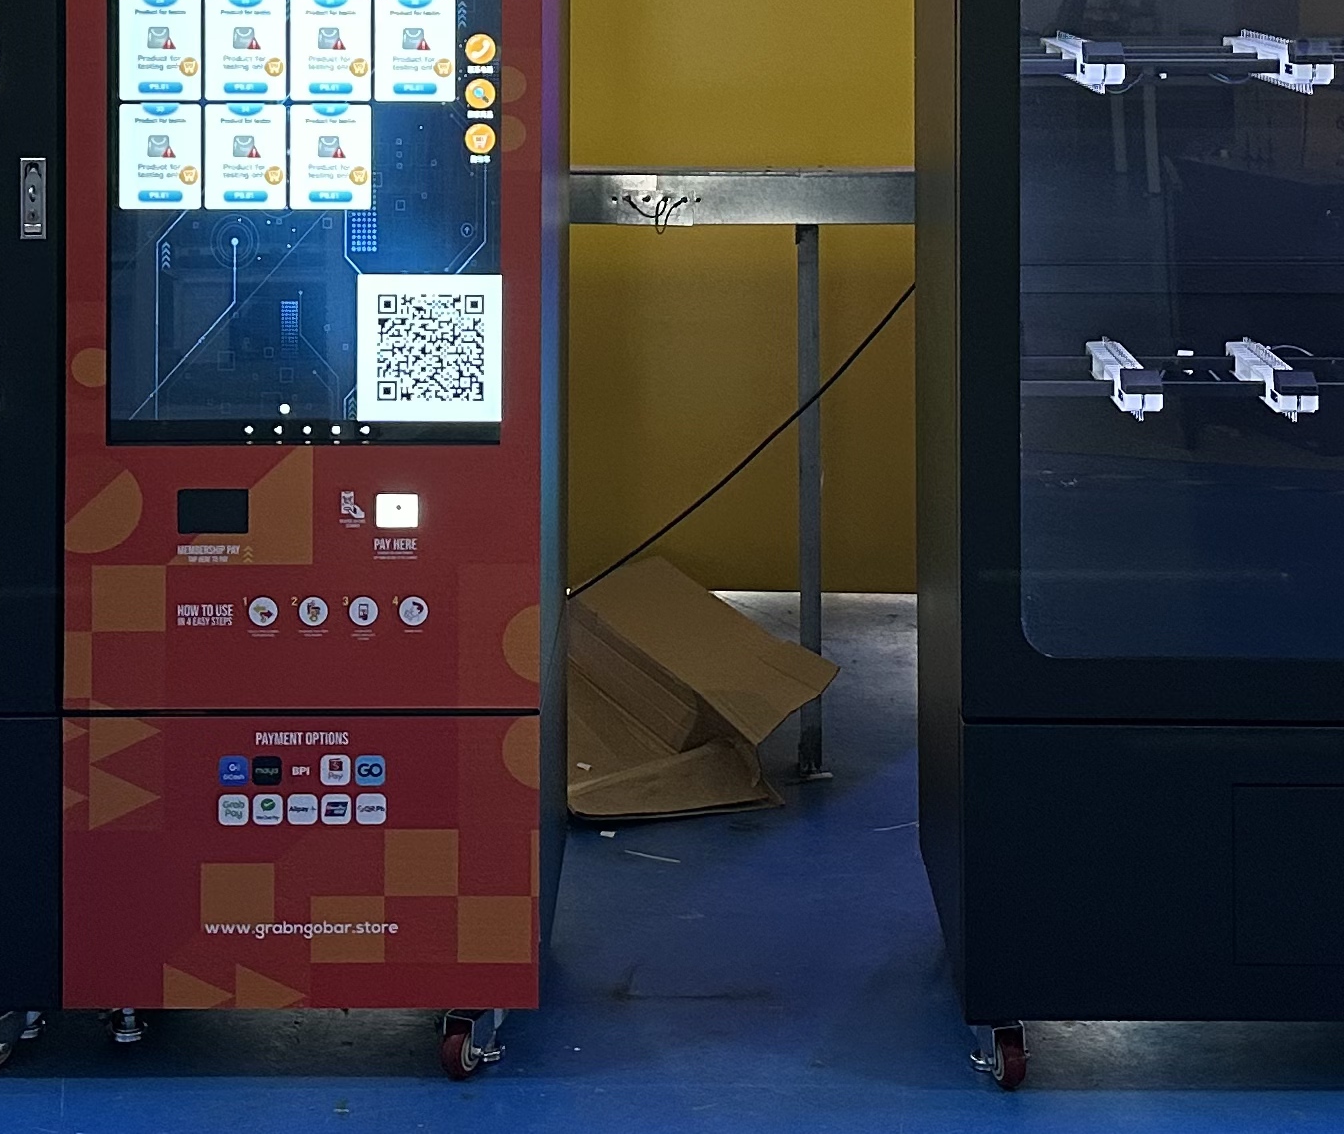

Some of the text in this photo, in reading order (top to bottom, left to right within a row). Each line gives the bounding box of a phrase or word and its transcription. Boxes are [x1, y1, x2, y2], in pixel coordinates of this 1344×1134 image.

[137, 55, 181, 63] Product for
[223, 55, 267, 63] Product for
[308, 55, 352, 63] Product for
[392, 55, 436, 63] Product for
[137, 163, 181, 171] Product for
[223, 163, 267, 171] Product for
[308, 163, 352, 171] Product for
[374, 538, 418, 550] PAY HERE
[177, 545, 240, 555] MEMBERSHIP PAY
[242, 597, 248, 606] 1
[291, 596, 298, 606] 2
[342, 596, 349, 606] 3
[392, 596, 399, 606] 4
[178, 604, 234, 616] HOW TO USE
[186, 618, 192, 626] 4
[192, 617, 210, 626] EASY
[211, 617, 232, 626] STEPS
[256, 732, 348, 745] PAYMENT OPTIONS
[292, 767, 310, 776] BPI
[358, 764, 383, 778] GO
[328, 772, 343, 782] Pay
[225, 810, 242, 819] Pay
[205, 921, 398, 939] www.grabngobar.store
